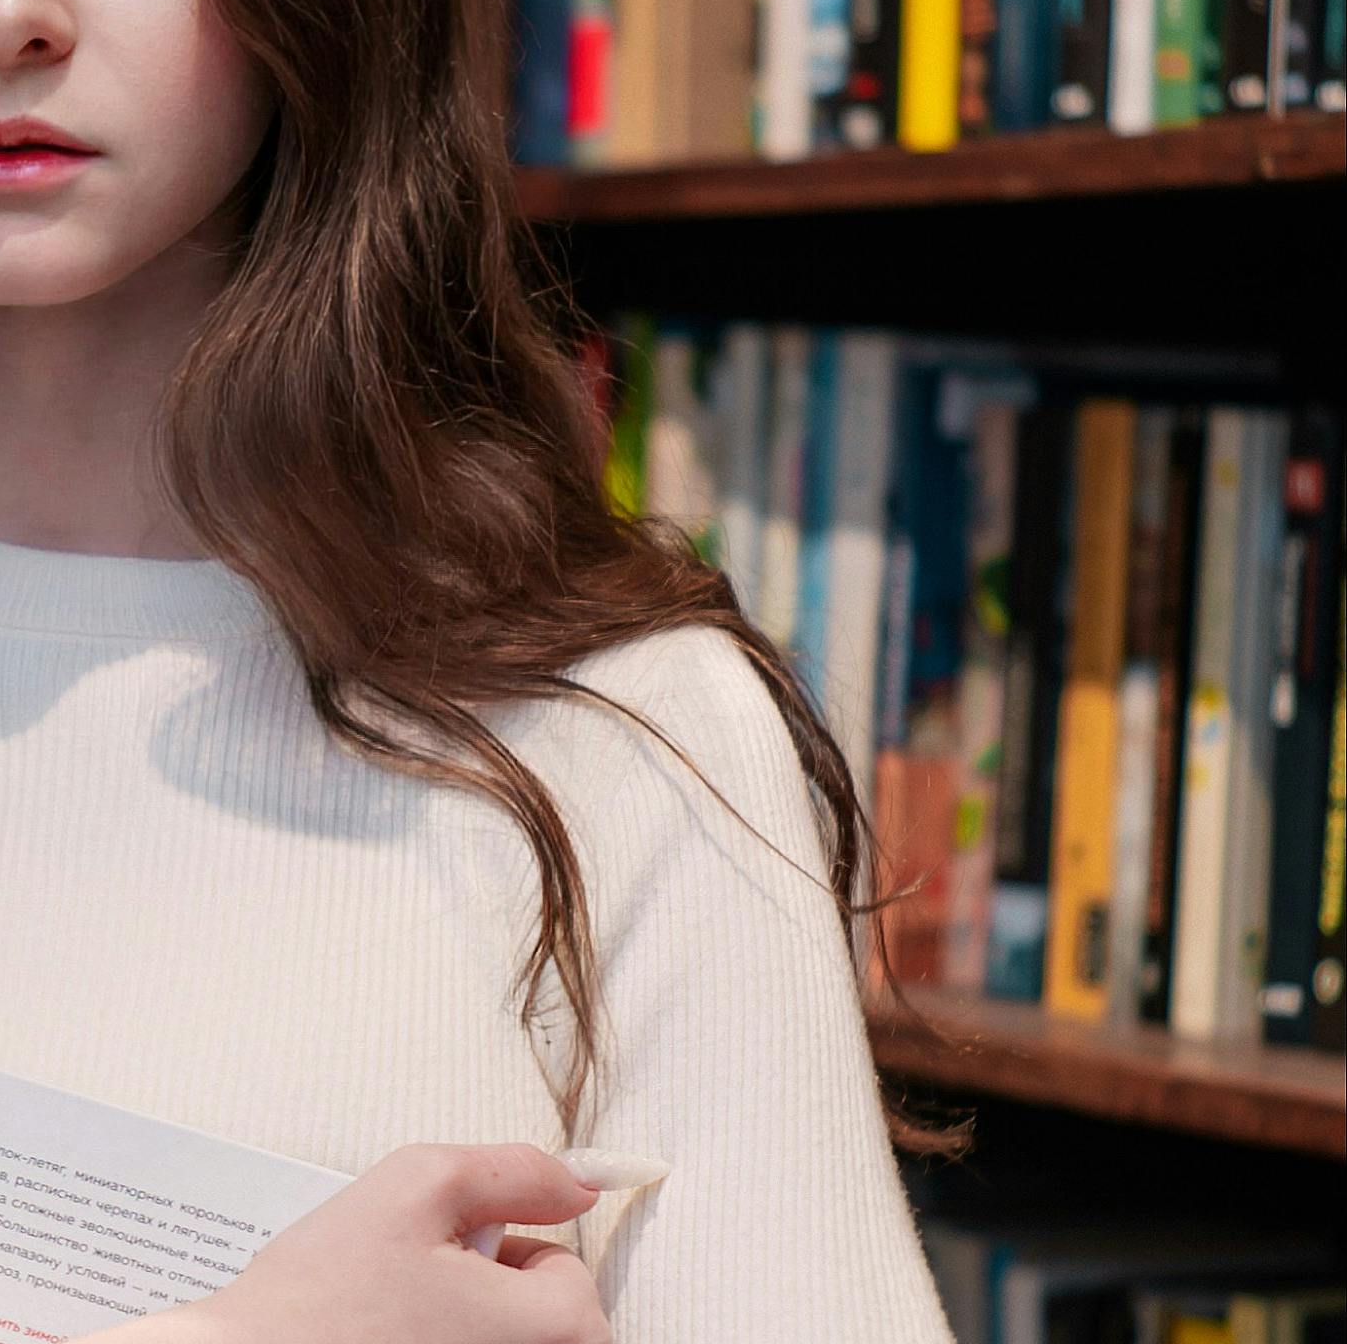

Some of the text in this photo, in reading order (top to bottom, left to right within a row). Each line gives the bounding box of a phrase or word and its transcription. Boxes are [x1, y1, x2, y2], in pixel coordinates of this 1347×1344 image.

[14, 1176, 91, 1206] расписных
[96, 1201, 153, 1225] черепах
[158, 1221, 167, 1229] и
[171, 1225, 231, 1250] лягушек
[74, 1170, 174, 1207] миниатюрных
[180, 1203, 255, 1233] корольков
[262, 1229, 271, 1237] и
[12, 1198, 75, 1225] сложные
[79, 1220, 188, 1260] эволюционные
[194, 1255, 244, 1275] механи
[25, 1273, 147, 1316] пронизывающий
[66, 1263, 126, 1288] условий
[149, 1288, 168, 1301] им
[93, 1248, 164, 1276] животных
[168, 1271, 224, 1292] отличн
